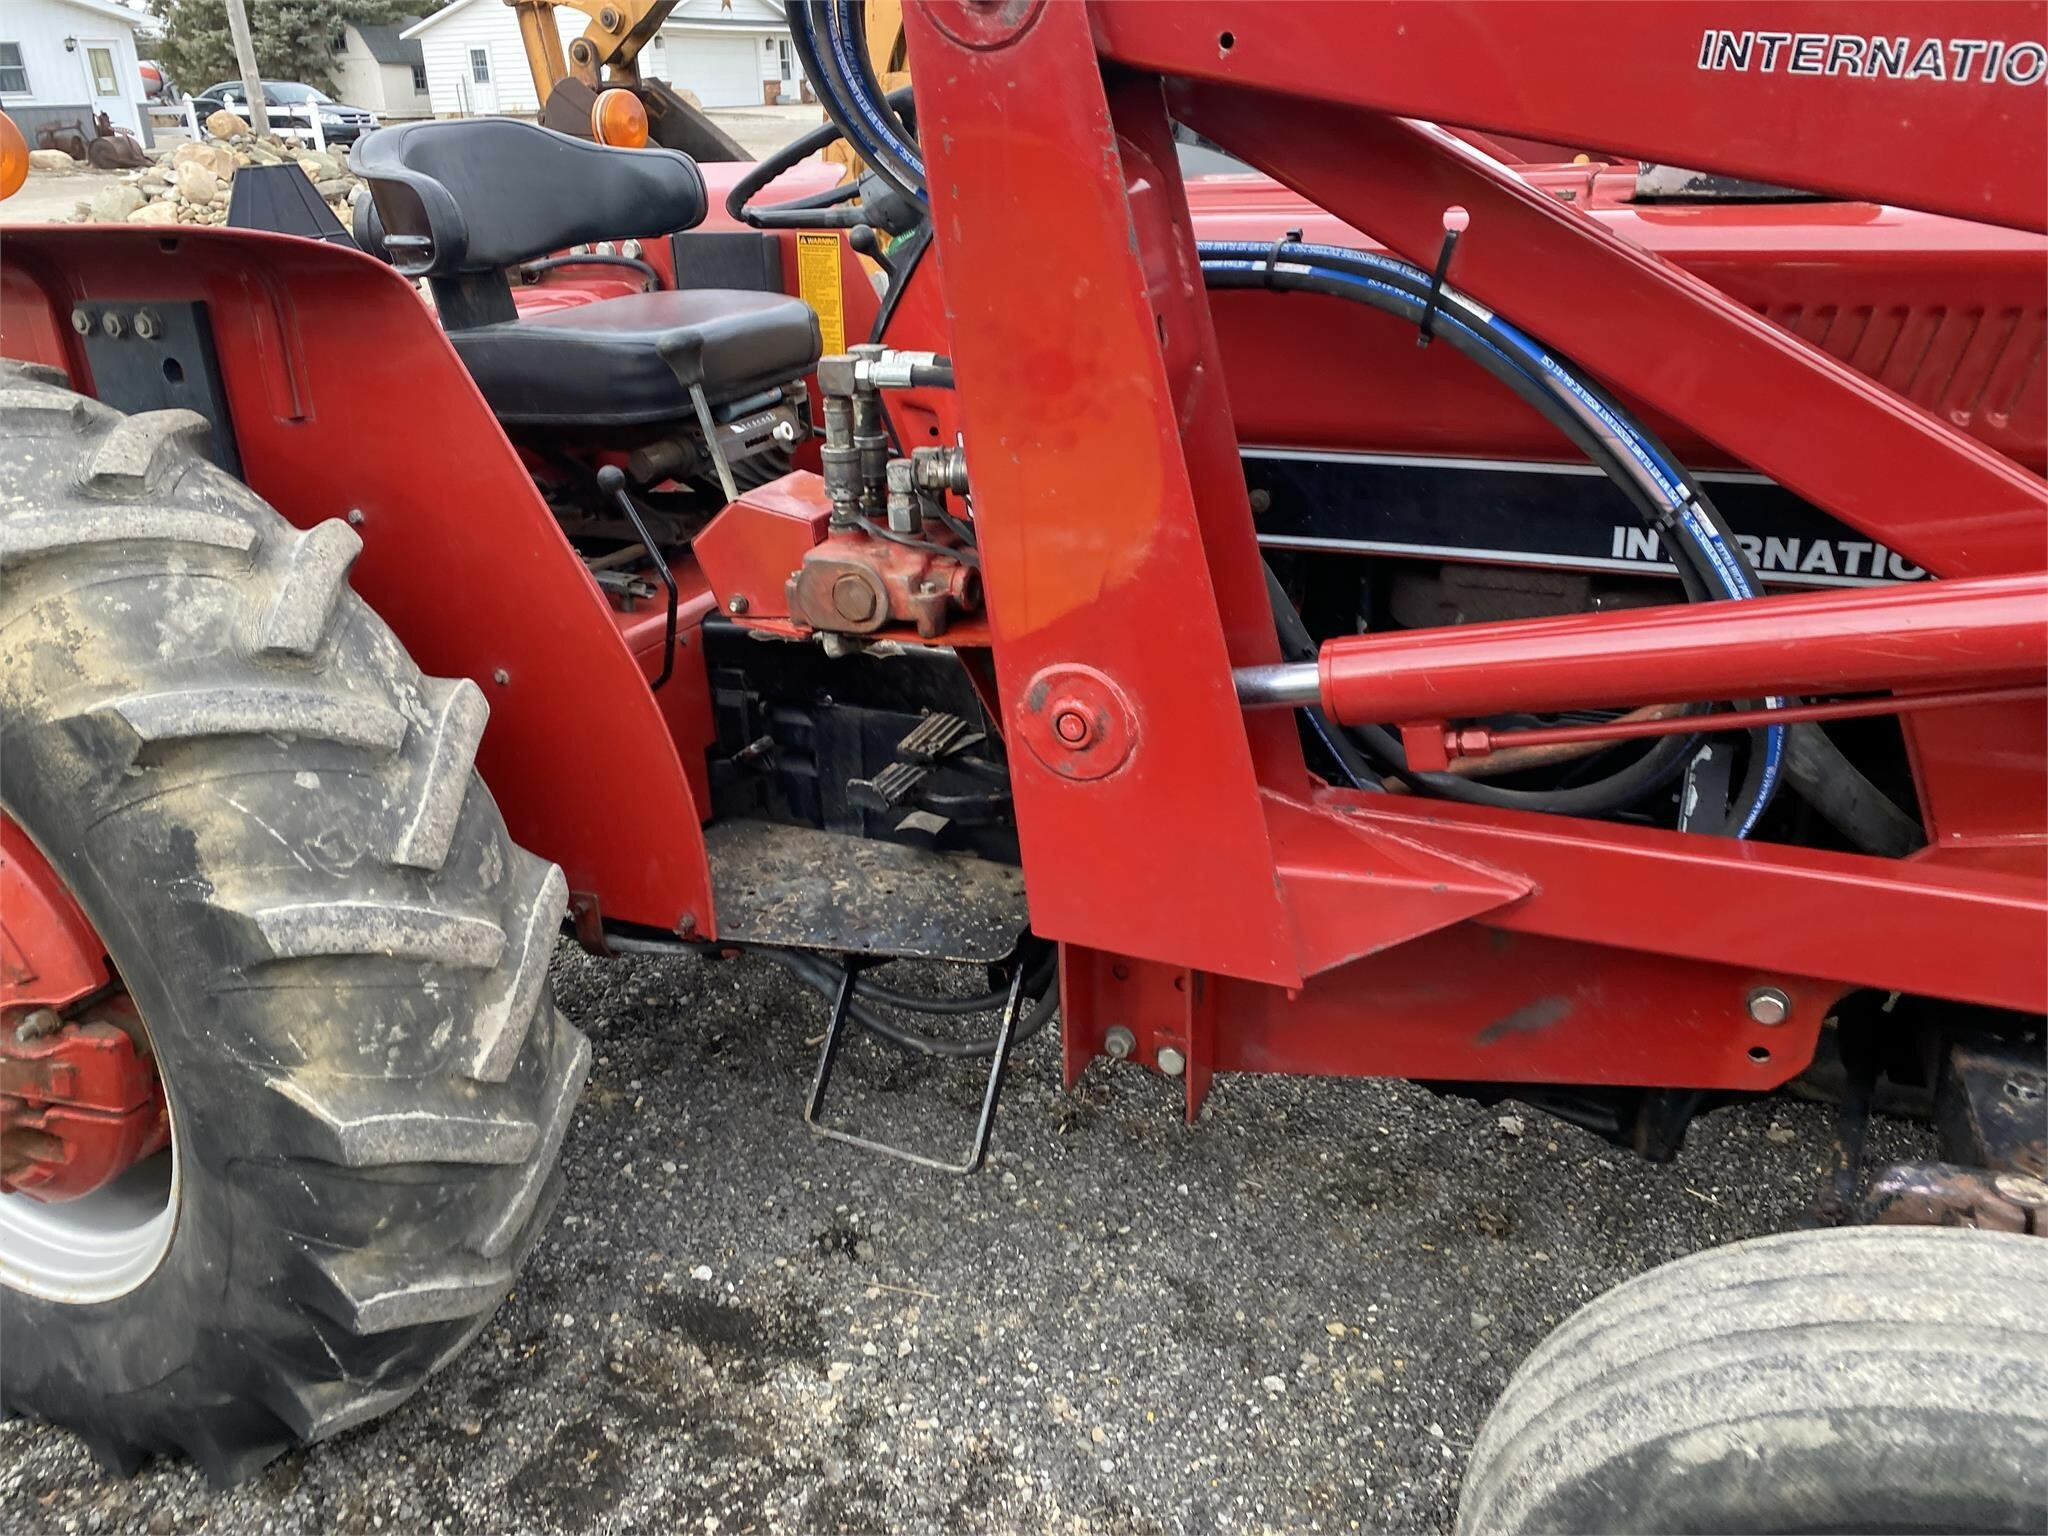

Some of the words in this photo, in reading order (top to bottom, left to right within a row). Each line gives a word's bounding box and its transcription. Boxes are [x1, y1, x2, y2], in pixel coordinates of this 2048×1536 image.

[1697, 29, 2048, 87] INTERNATIO
[807, 236, 838, 246] WARNING
[1612, 525, 1940, 581] INRNATIO
